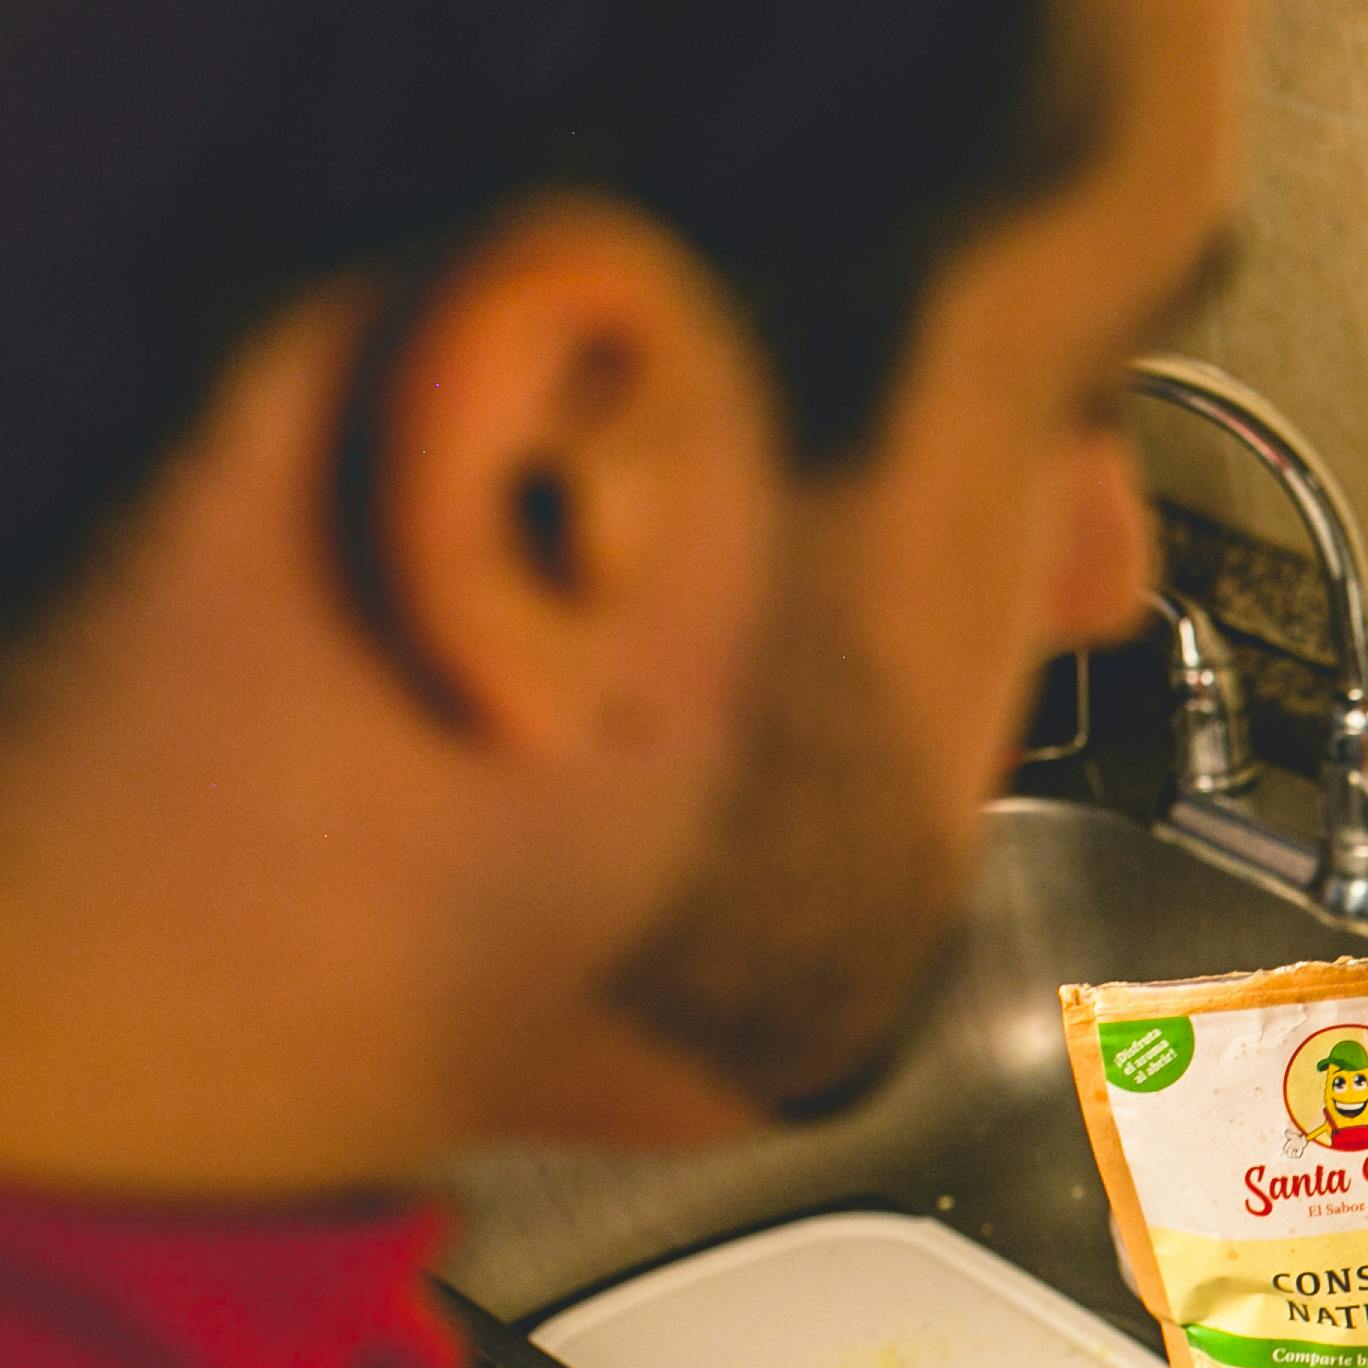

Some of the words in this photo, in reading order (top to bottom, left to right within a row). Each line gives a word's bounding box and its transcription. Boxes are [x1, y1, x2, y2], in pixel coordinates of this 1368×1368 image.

[1244, 1165, 1351, 1217] Santa
[1308, 1204, 1322, 1217] El
[1326, 1202, 1365, 1216] Sabor
[1272, 1347, 1352, 1367] Comparte
